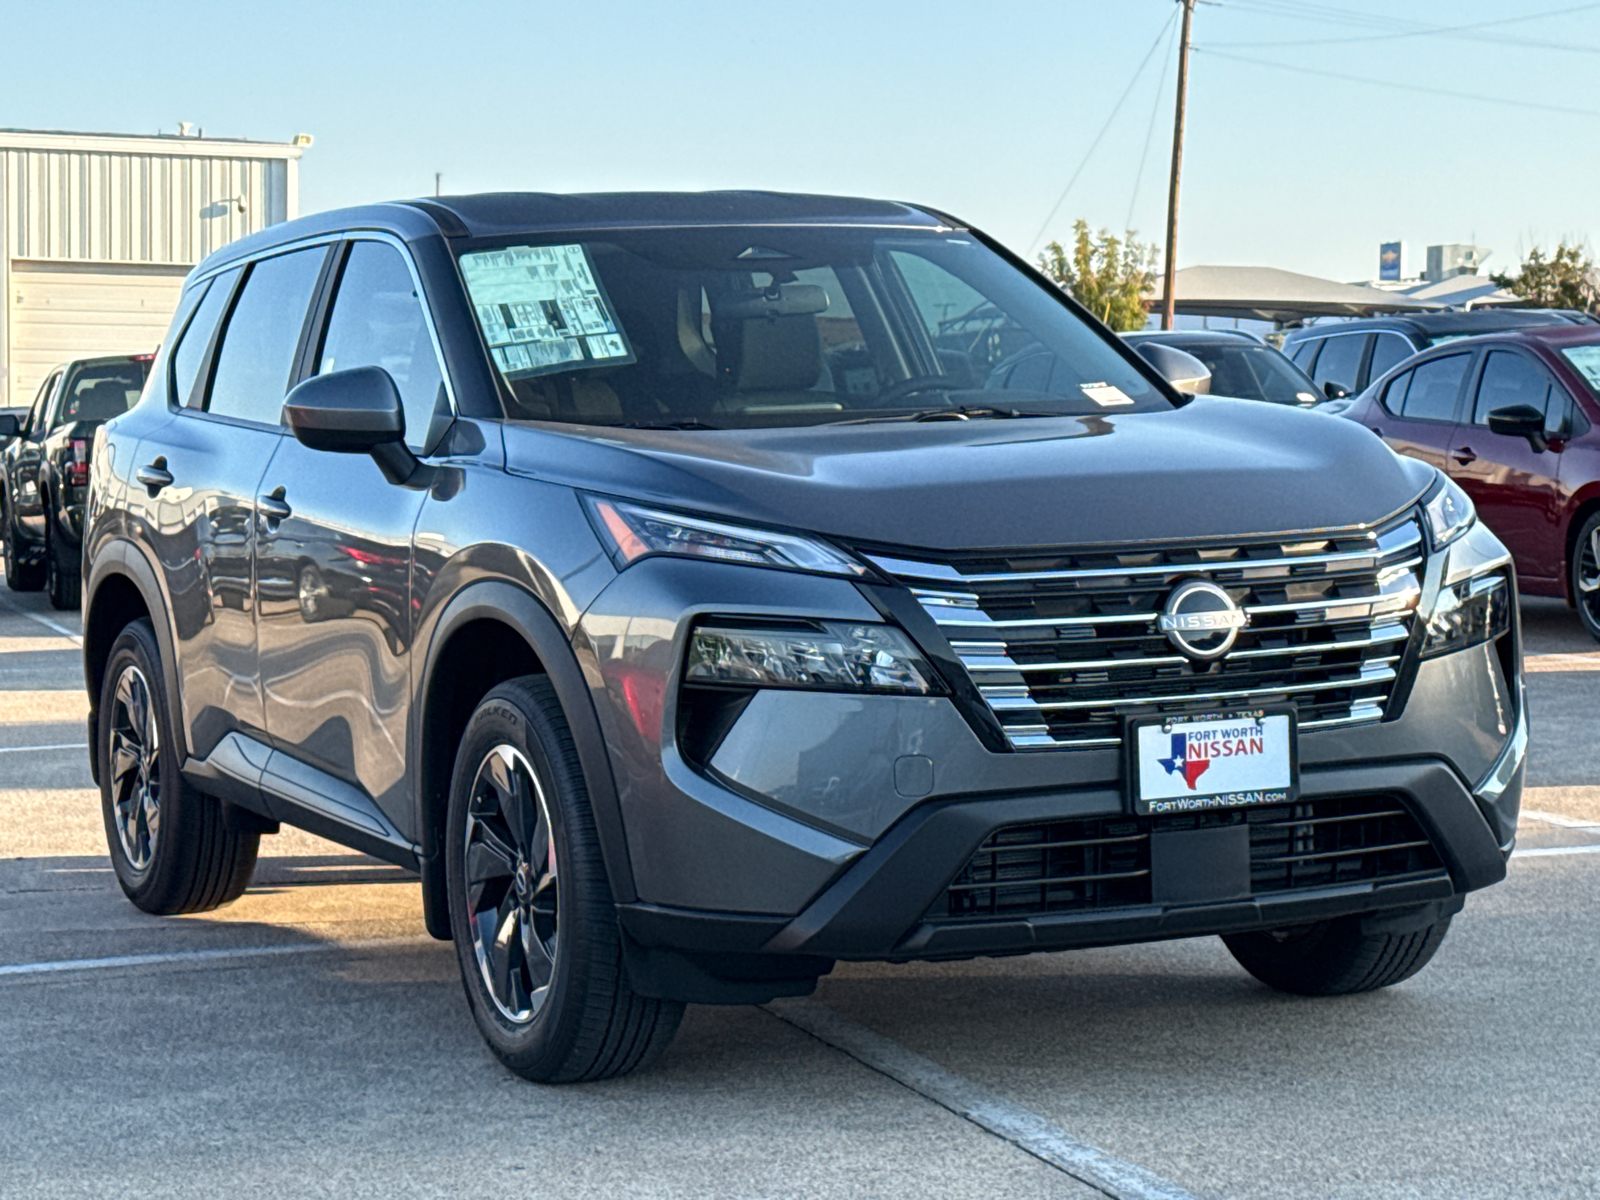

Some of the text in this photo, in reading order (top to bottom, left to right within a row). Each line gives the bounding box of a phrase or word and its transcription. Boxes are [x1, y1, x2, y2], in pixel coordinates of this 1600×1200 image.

[1166, 709, 1264, 724] FORT WORTH TEXAS
[1188, 726, 1263, 741] FORT WORTH
[1188, 738, 1264, 759] NISSAN
